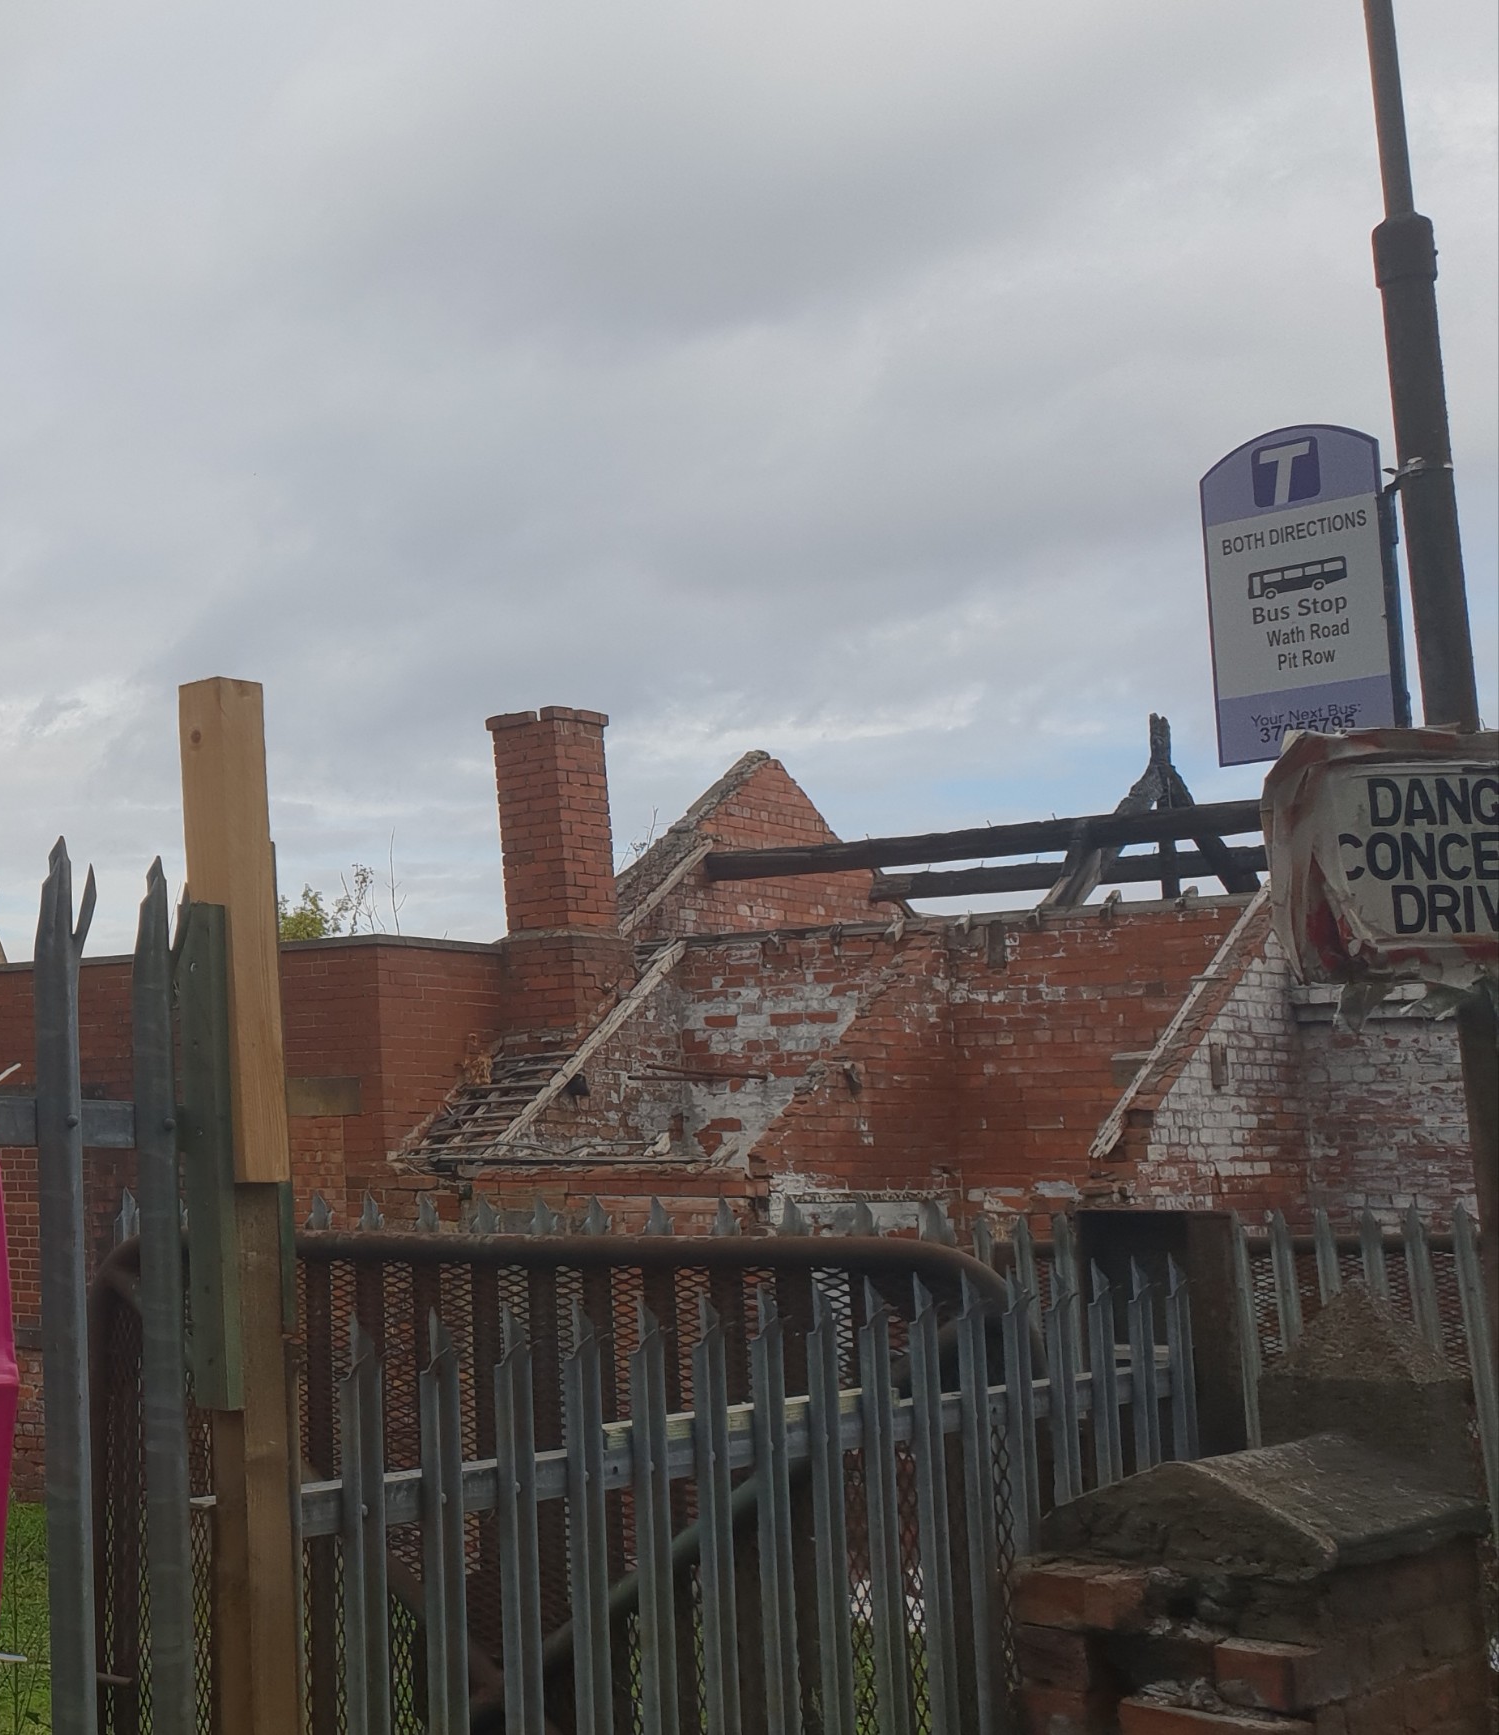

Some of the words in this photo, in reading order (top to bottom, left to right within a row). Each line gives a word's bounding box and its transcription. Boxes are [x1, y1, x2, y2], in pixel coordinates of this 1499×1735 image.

[1222, 531, 1265, 556] BOTH
[1269, 509, 1367, 546] DIRECTIONS
[1252, 605, 1290, 625] Bus
[1297, 596, 1348, 617] Stop
[1266, 626, 1305, 647] Wath
[1310, 617, 1350, 641] Road
[1277, 652, 1299, 671] Pit
[1302, 649, 1336, 667] Row
[1251, 712, 1284, 727] Your
[1289, 707, 1323, 723] Next
[1327, 702, 1362, 717] Bus:
[1367, 777, 1499, 827] DANG
